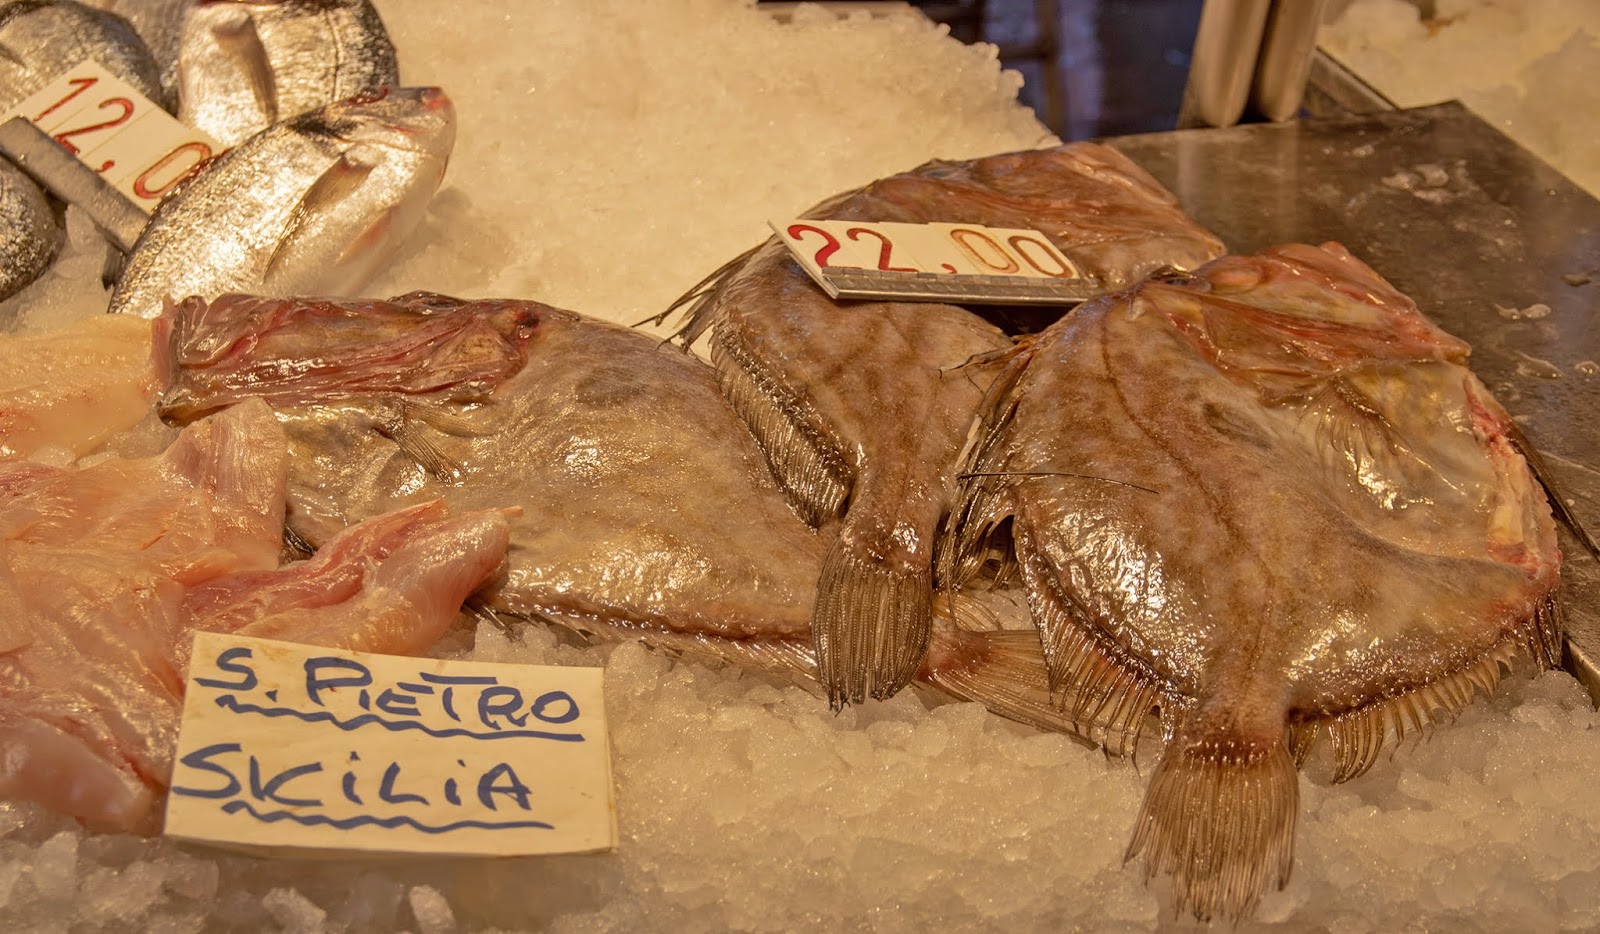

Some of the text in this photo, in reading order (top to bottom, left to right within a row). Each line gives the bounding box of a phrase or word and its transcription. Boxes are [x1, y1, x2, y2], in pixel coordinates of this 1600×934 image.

[787, 224, 1073, 279] 22,00
[194, 647, 580, 730] S. PIETRO
